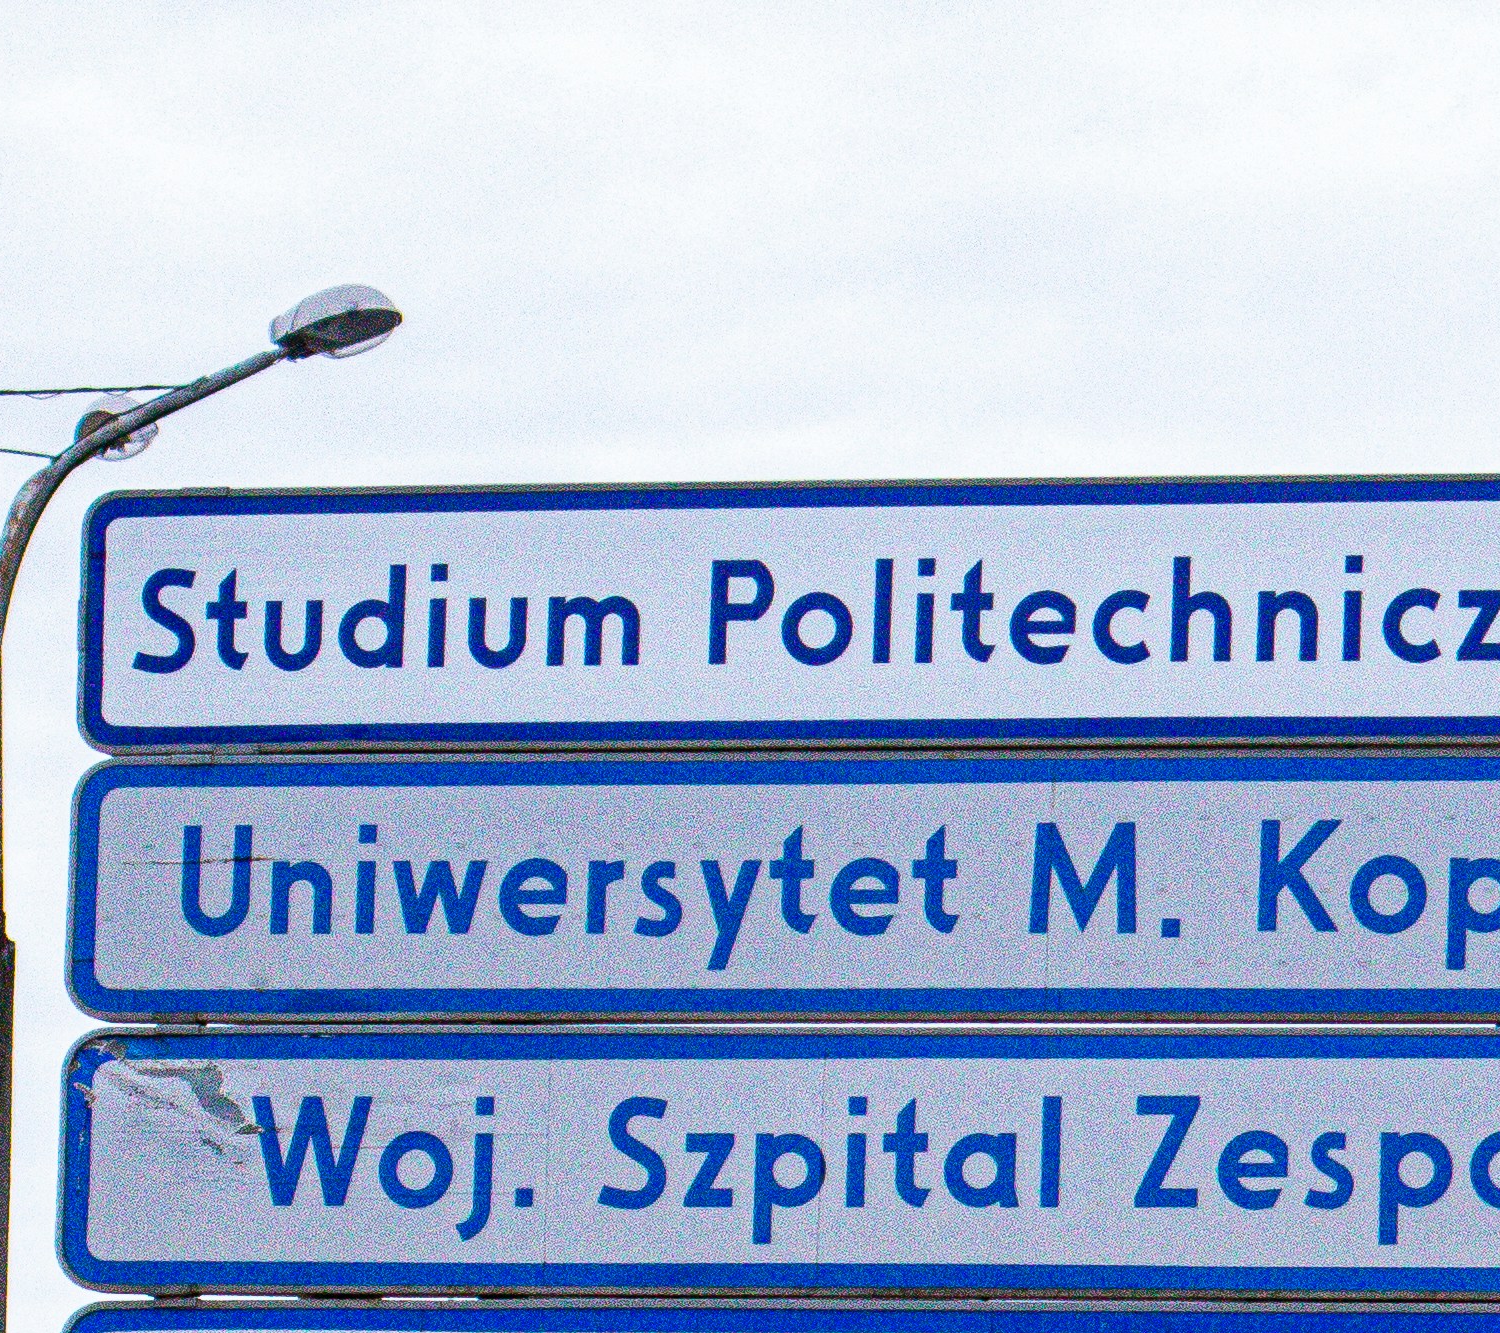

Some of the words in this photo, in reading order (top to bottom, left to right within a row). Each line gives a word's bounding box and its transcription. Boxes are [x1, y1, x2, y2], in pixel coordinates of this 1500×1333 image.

[134, 564, 640, 673] Studium
[183, 825, 957, 969] Uniwersytet
[1031, 823, 1180, 937] M.
[254, 1097, 533, 1239] Woj.
[600, 1097, 1061, 1243] Szpital
